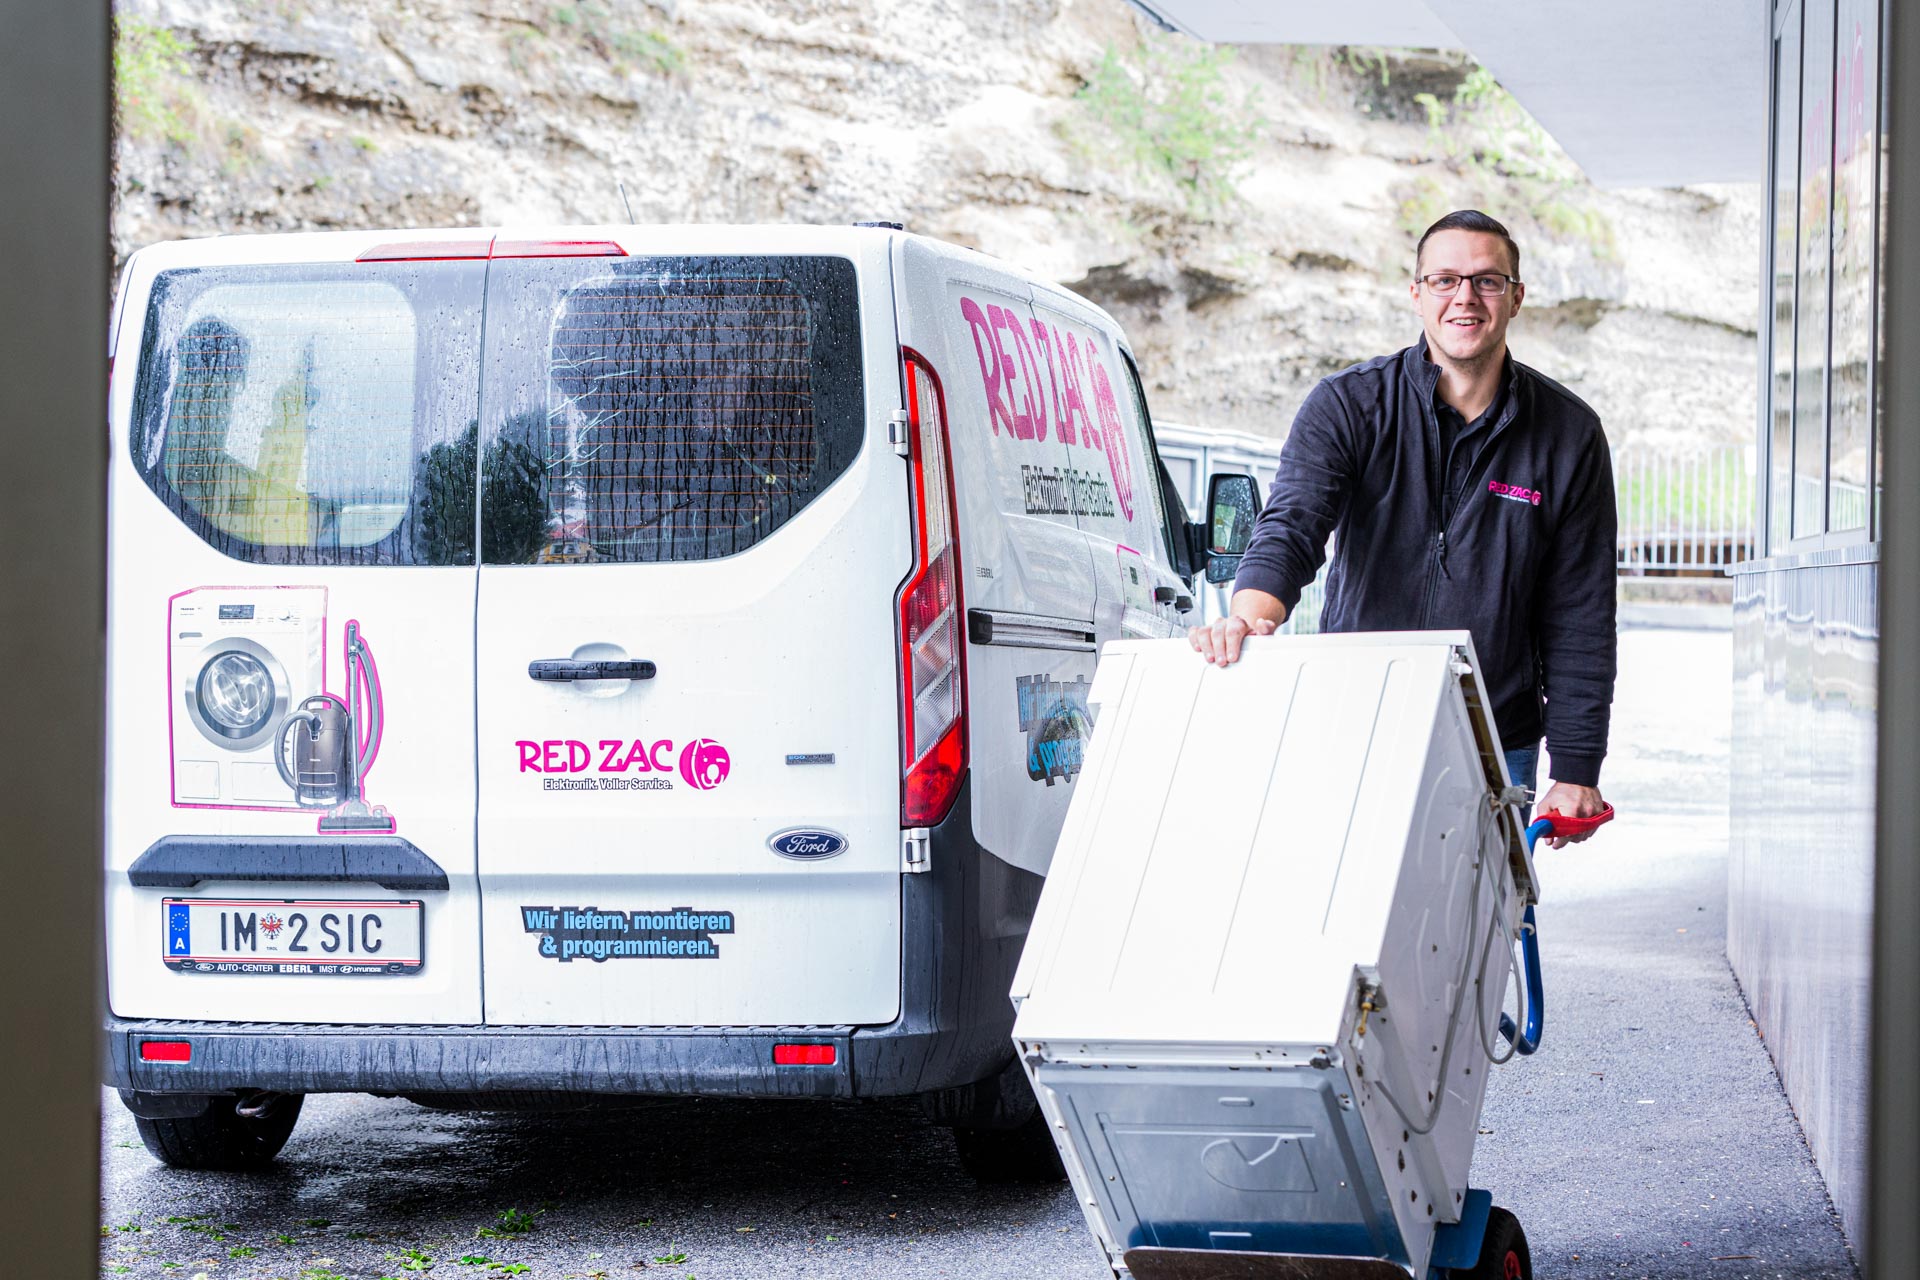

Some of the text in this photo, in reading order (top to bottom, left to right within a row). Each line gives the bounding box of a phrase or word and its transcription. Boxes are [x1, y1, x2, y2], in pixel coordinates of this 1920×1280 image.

[960, 296, 1103, 451] RED ZAC
[1488, 480, 1509, 494] RED
[1509, 485, 1532, 499] ZAC
[515, 739, 673, 773] RED ZAC
[543, 778, 673, 790] Elektronik. Voller Service.
[786, 836, 830, 854] Ford
[220, 911, 257, 952] IM
[525, 910, 731, 933] Wir liefern, montieren
[174, 937, 186, 950] A
[542, 936, 716, 959] & programmieren.
[279, 964, 314, 973] EBERL
[319, 965, 338, 973] IMST
